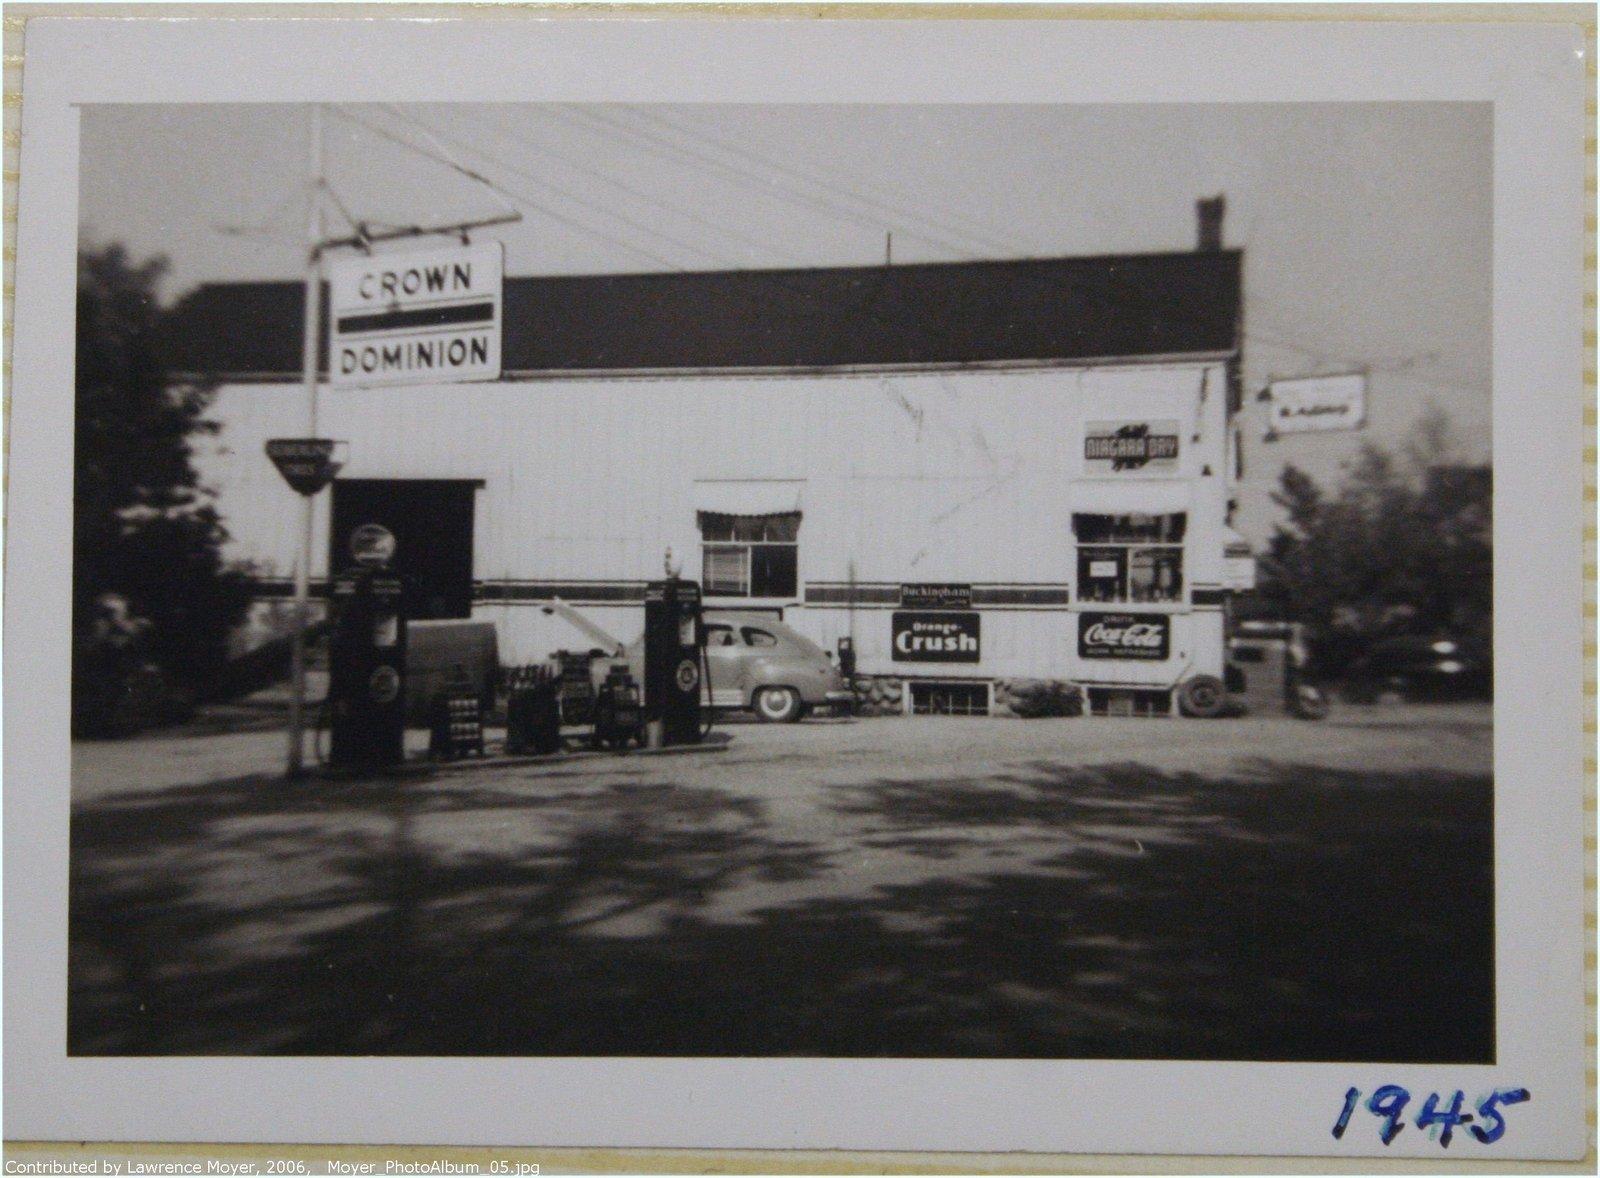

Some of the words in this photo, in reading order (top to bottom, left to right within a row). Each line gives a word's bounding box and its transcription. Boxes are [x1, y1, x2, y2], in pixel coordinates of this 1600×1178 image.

[358, 262, 472, 300] CROWN
[340, 336, 489, 375] DOMINION
[1086, 438, 1145, 457] NIAGARA
[903, 585, 970, 598] Buckingham
[896, 630, 977, 654] Crush
[1331, 1084, 1531, 1149] 1945
